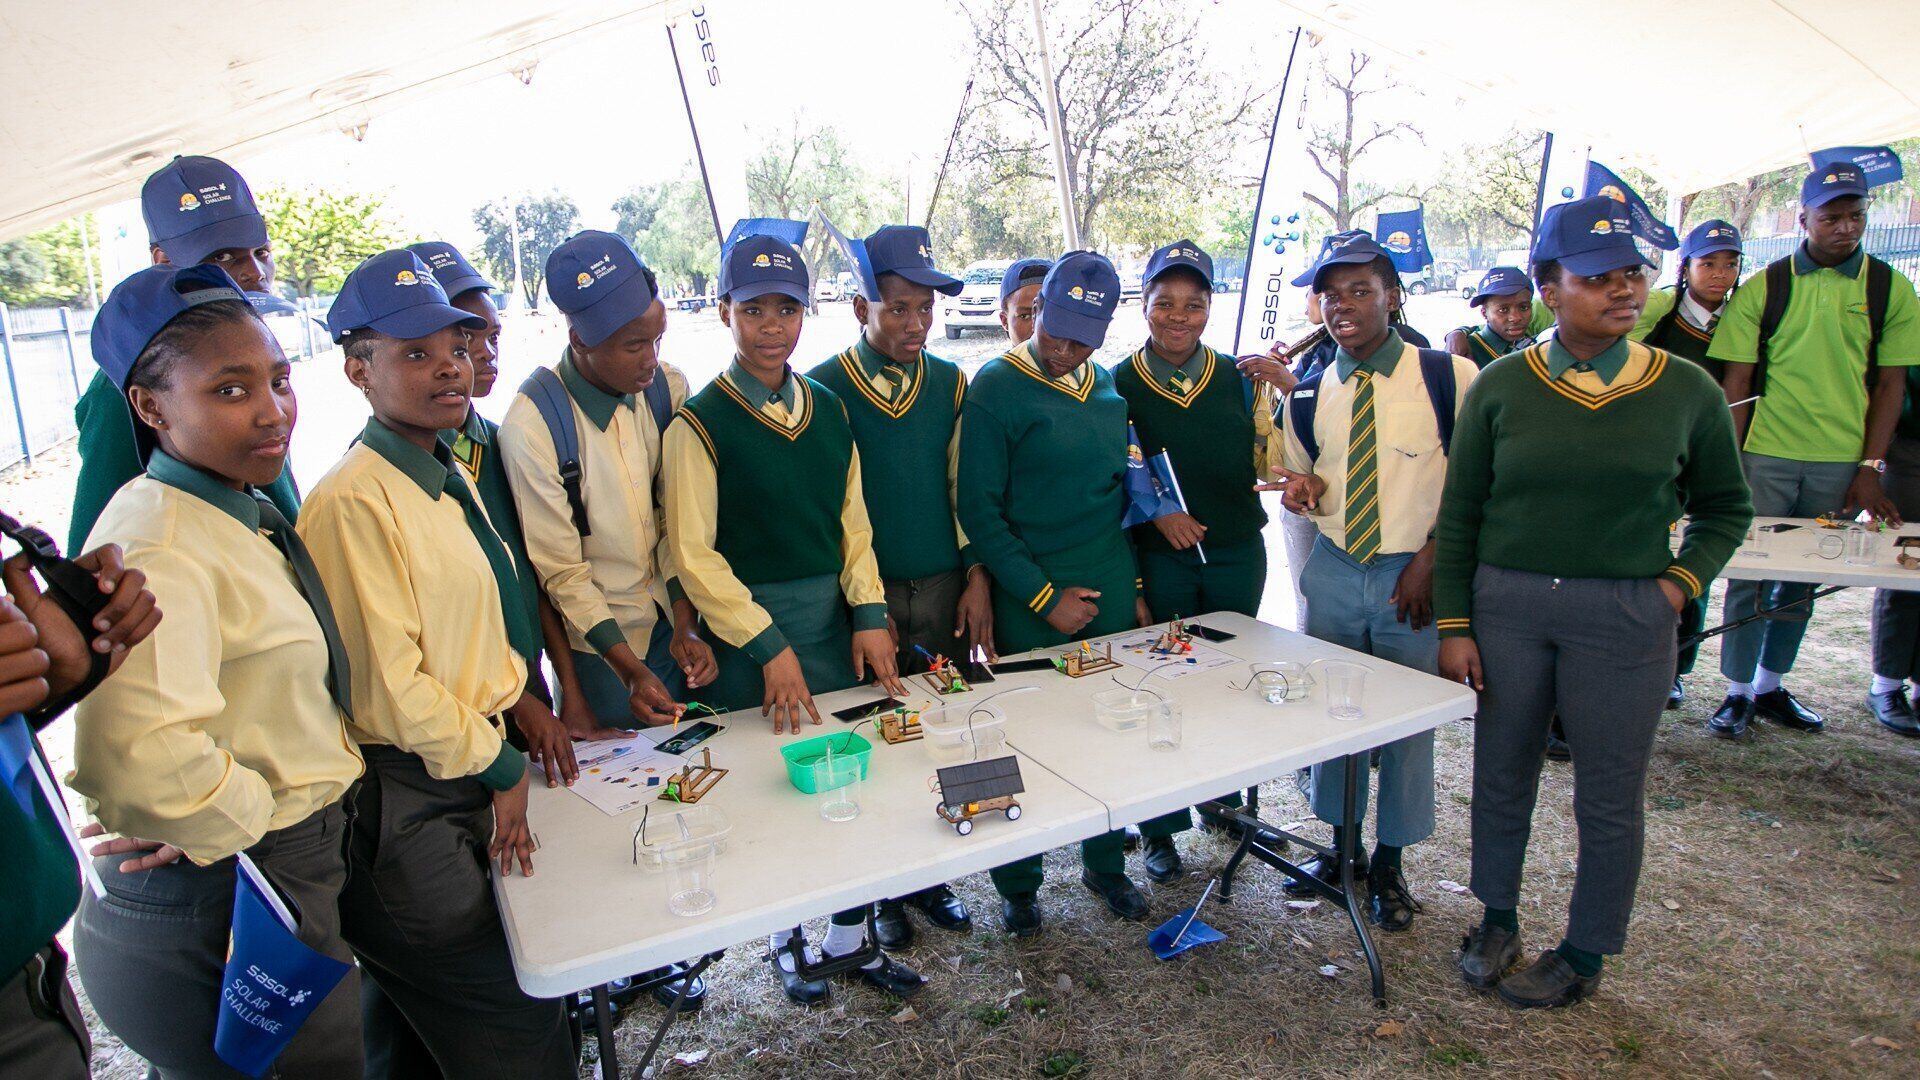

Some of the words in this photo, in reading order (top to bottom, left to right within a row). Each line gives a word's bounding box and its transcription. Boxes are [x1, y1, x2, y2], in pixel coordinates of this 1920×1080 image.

[203, 192, 220, 200] SOLAR
[205, 195, 231, 205] CHALLENGE
[232, 978, 271, 1012] SOLAR
[224, 987, 282, 1035] CHALLENGE
